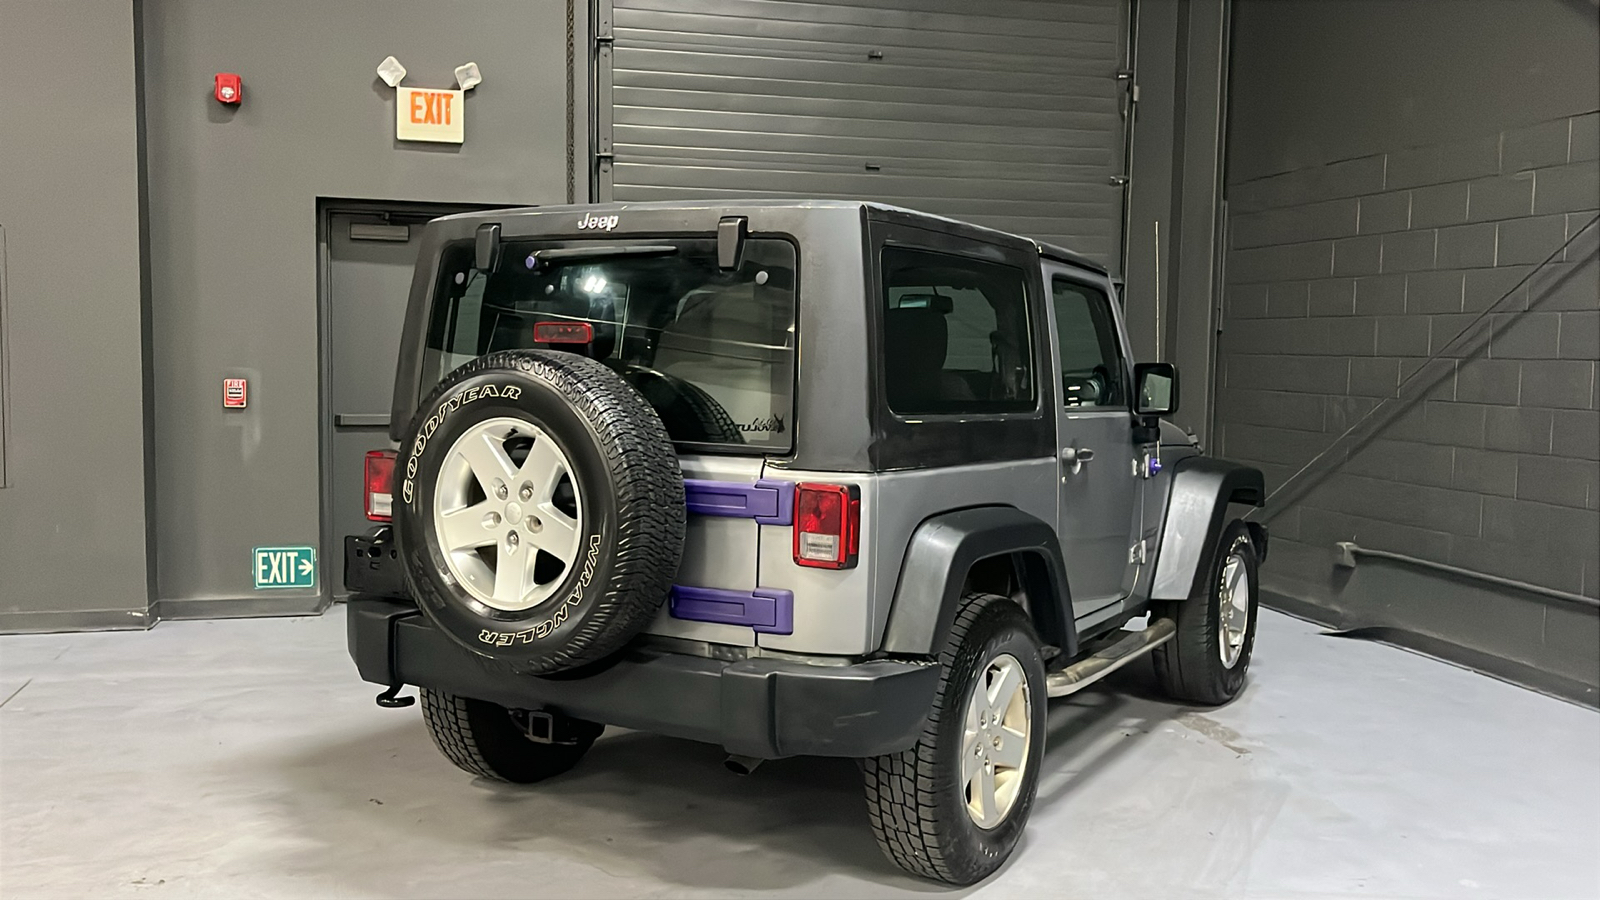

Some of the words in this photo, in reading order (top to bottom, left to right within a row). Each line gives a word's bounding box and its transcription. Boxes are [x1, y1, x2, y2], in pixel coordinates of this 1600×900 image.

[410, 91, 454, 126] EXIT
[577, 212, 619, 232] Jeep
[403, 384, 522, 504] GOODYEAR
[257, 551, 299, 584] EXIT
[478, 534, 601, 647] WRANGLER
